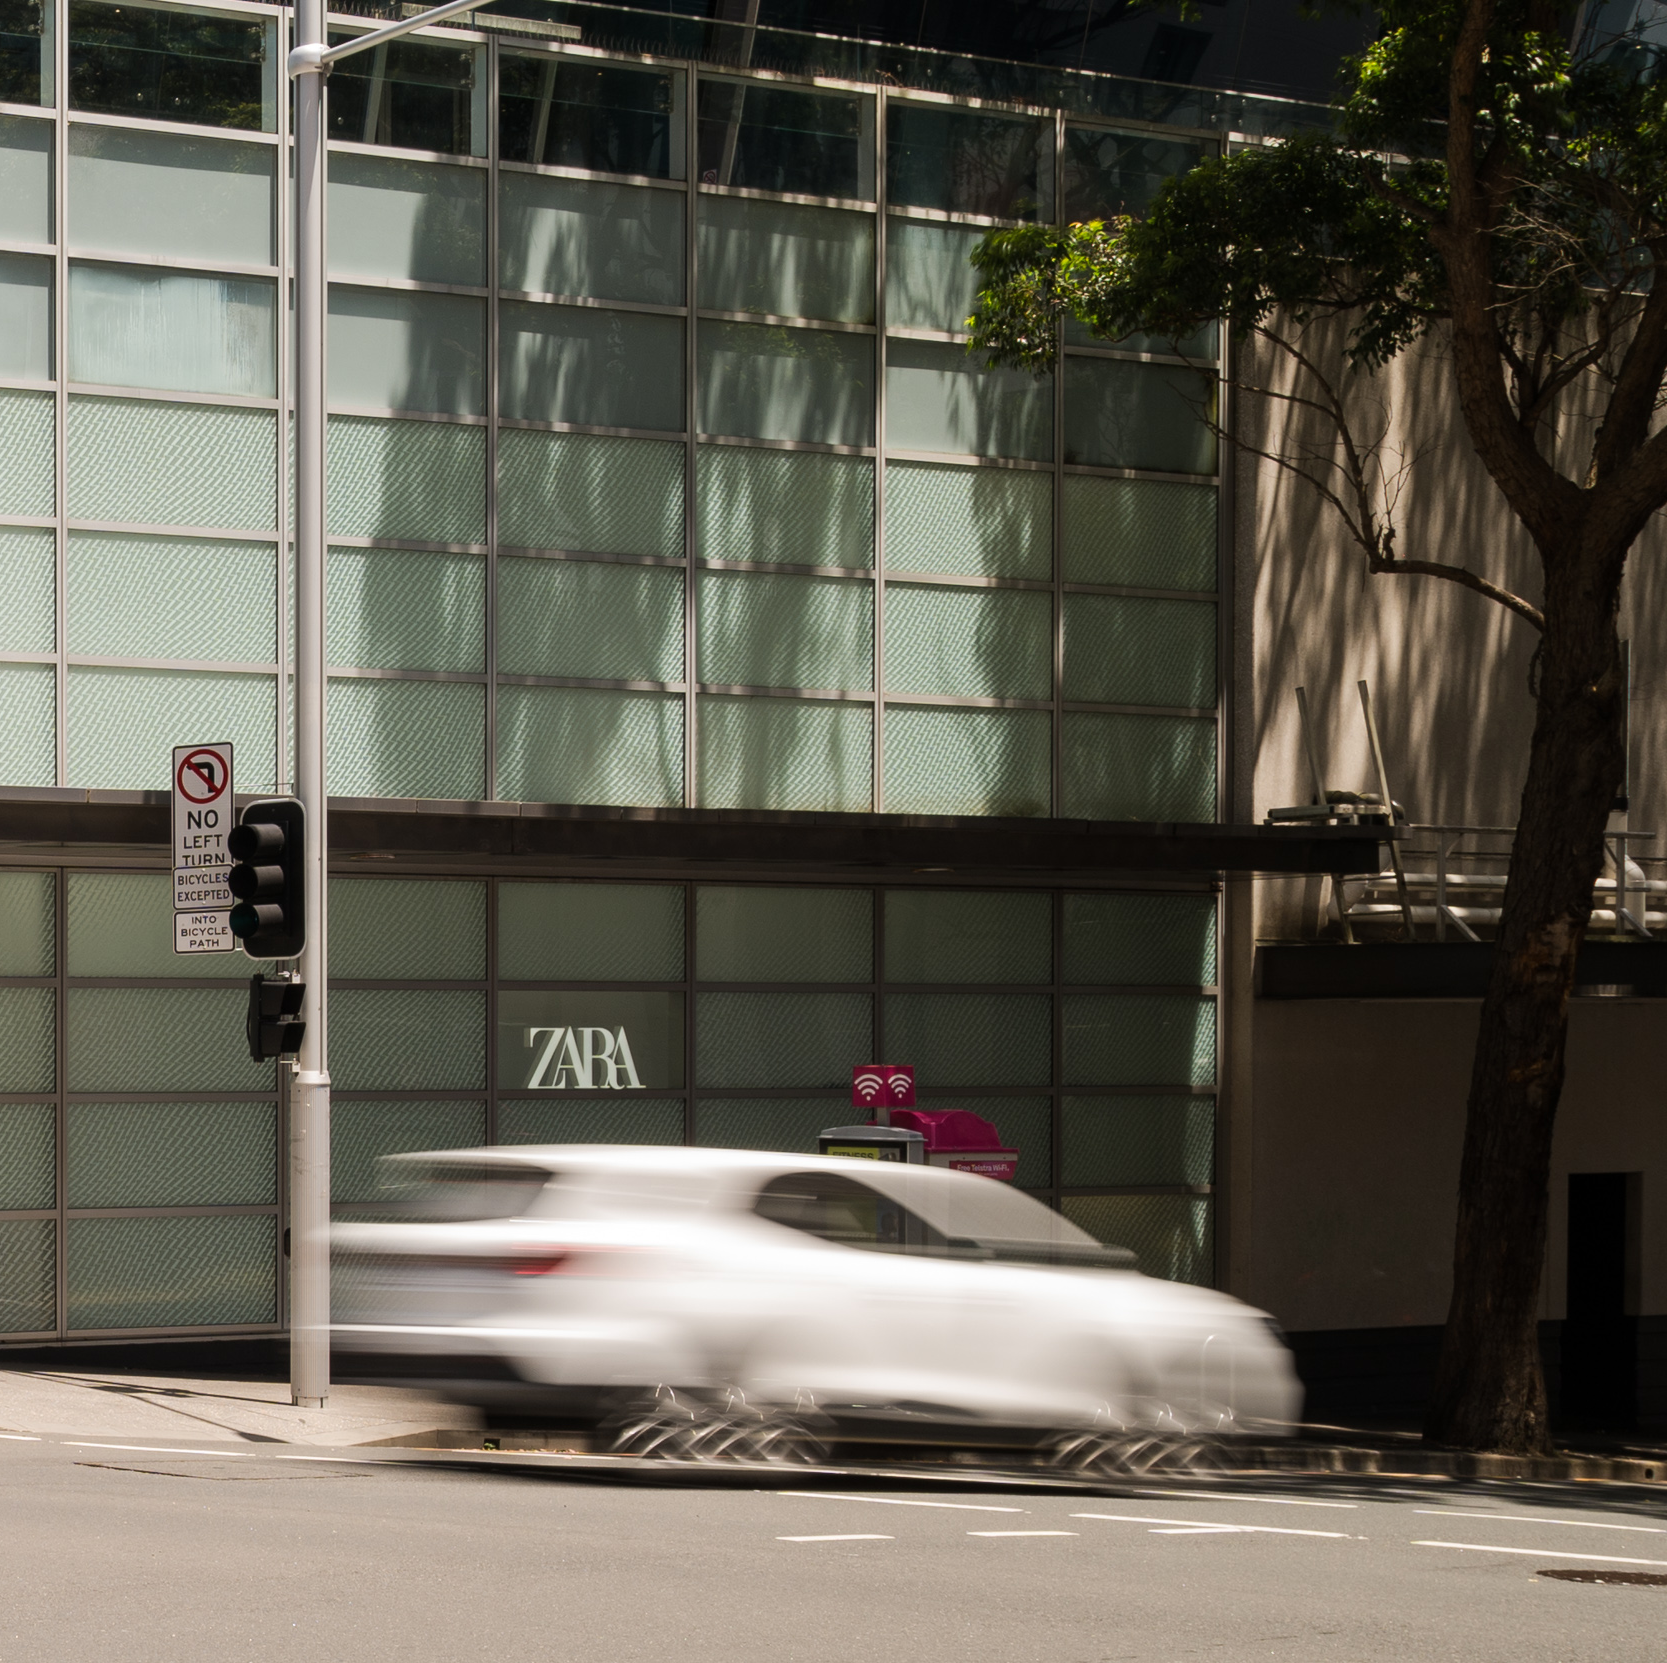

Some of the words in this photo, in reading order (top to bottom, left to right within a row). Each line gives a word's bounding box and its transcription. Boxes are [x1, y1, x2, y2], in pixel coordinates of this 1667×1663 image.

[187, 810, 219, 829] NO
[183, 834, 223, 850] LEFT
[182, 852, 225, 866] TURN
[177, 872, 229, 885] BICYCLES
[177, 889, 230, 902] EXCEPTED
[191, 915, 217, 924] INTO
[181, 926, 228, 937] BICYCLE
[190, 939, 219, 948] PATH
[528, 1025, 646, 1090] ZARA
